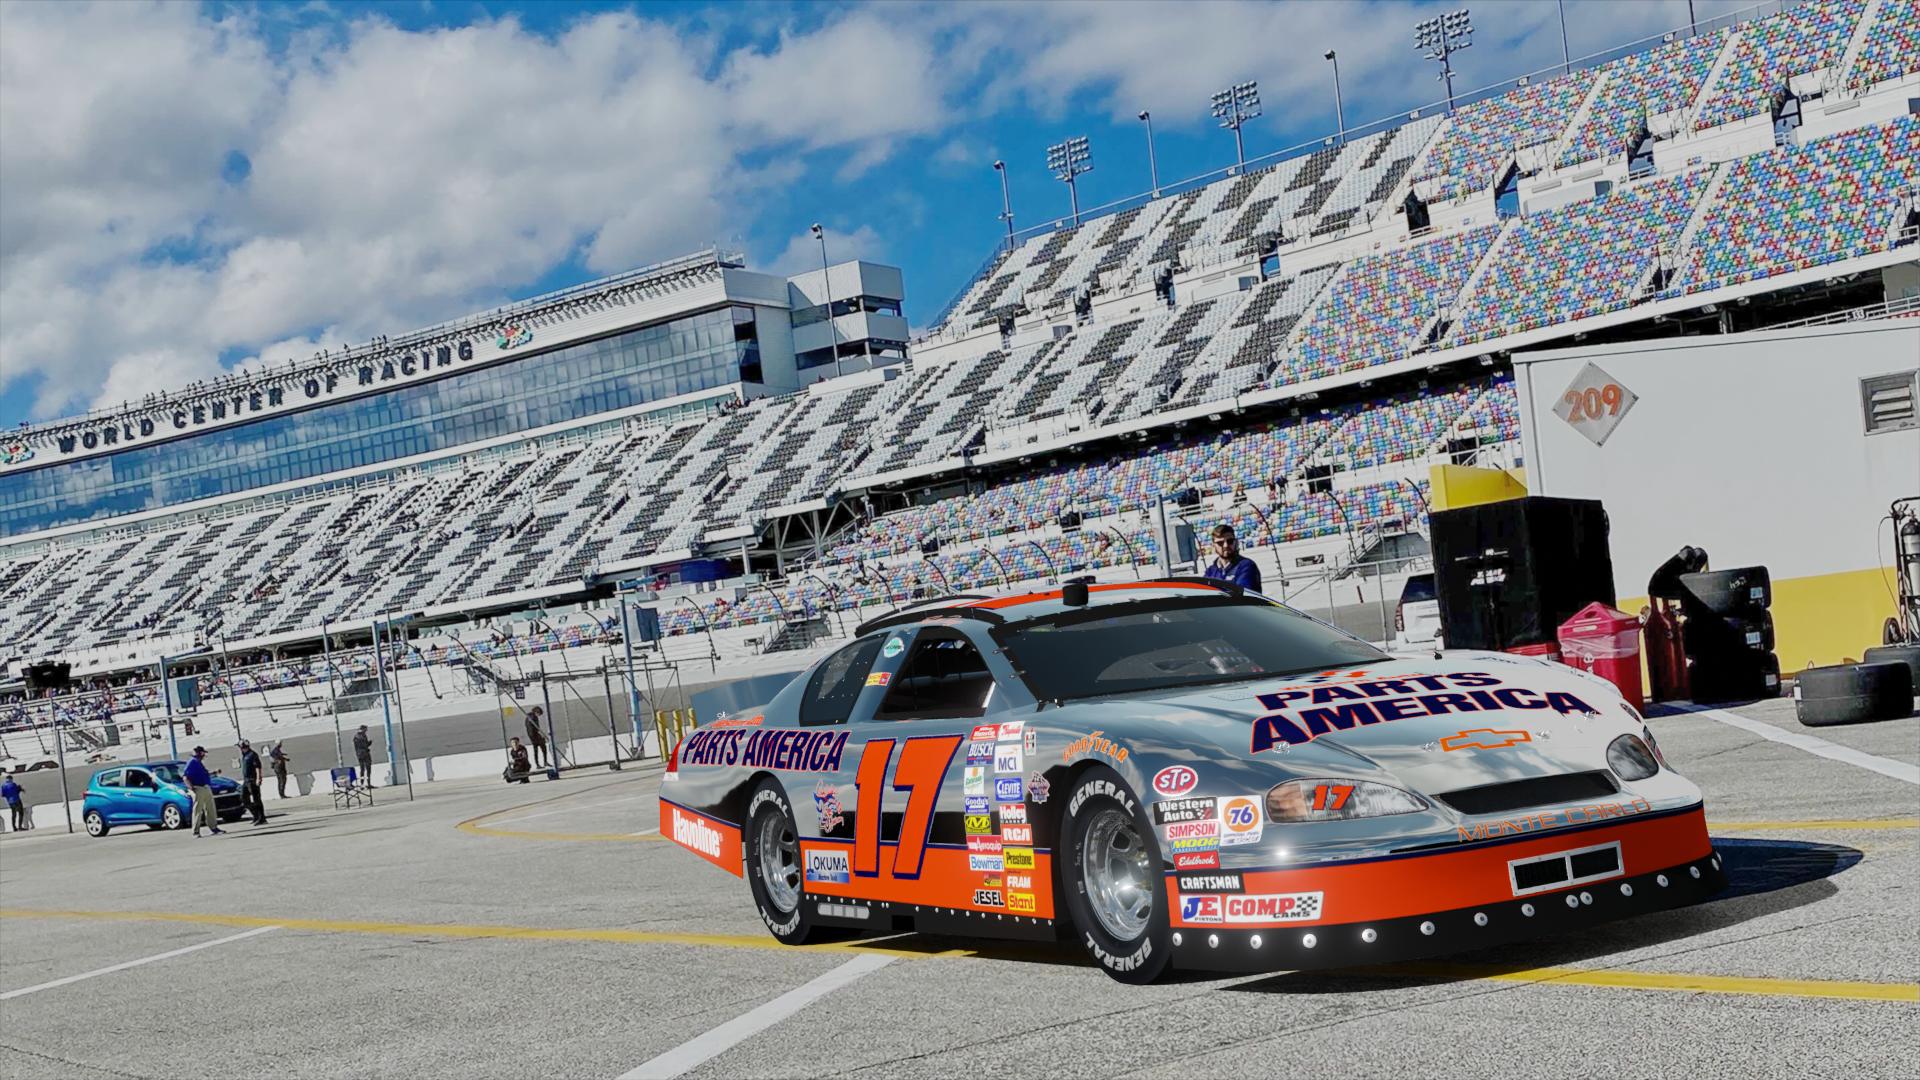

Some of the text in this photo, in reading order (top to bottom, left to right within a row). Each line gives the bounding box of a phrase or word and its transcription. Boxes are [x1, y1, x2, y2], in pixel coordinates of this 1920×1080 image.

[58, 418, 154, 454] WORLD
[173, 386, 284, 429] CENTER
[304, 373, 339, 399] OF
[358, 340, 473, 386] RACING
[1564, 384, 1622, 425] 209
[1253, 671, 1504, 711] PARTS
[1250, 687, 1602, 755] AMERICA
[682, 728, 851, 773] PARTS AMERICA
[968, 742, 995, 757] BUSCH
[998, 757, 1017, 771] MCI
[1159, 768, 1192, 790] STP
[750, 789, 788, 818] GENERAL
[854, 734, 964, 880] 17
[1069, 780, 1134, 817] GENERAL
[1158, 800, 1214, 812] Western
[1312, 785, 1356, 811] 17
[1230, 806, 1253, 825] 76
[1457, 798, 1651, 843] MONTE CARLO
[672, 808, 721, 858] Havoline
[1003, 828, 1031, 842] RCA
[1168, 824, 1216, 839] SIMPSON
[1173, 838, 1219, 848] MOOG
[813, 856, 849, 871] OKUMA
[971, 856, 1003, 870] Bowman
[1006, 852, 1033, 866] Prestone
[1007, 876, 1031, 889] FRAM
[1180, 875, 1240, 890] CRAFTSMAN
[974, 890, 1005, 906] JESEL
[1009, 895, 1034, 910] Stant
[1182, 896, 1218, 919] JE
[1228, 896, 1296, 917] COMP
[1272, 910, 1311, 919] CAMS
[1085, 931, 1153, 972] GENERAL
